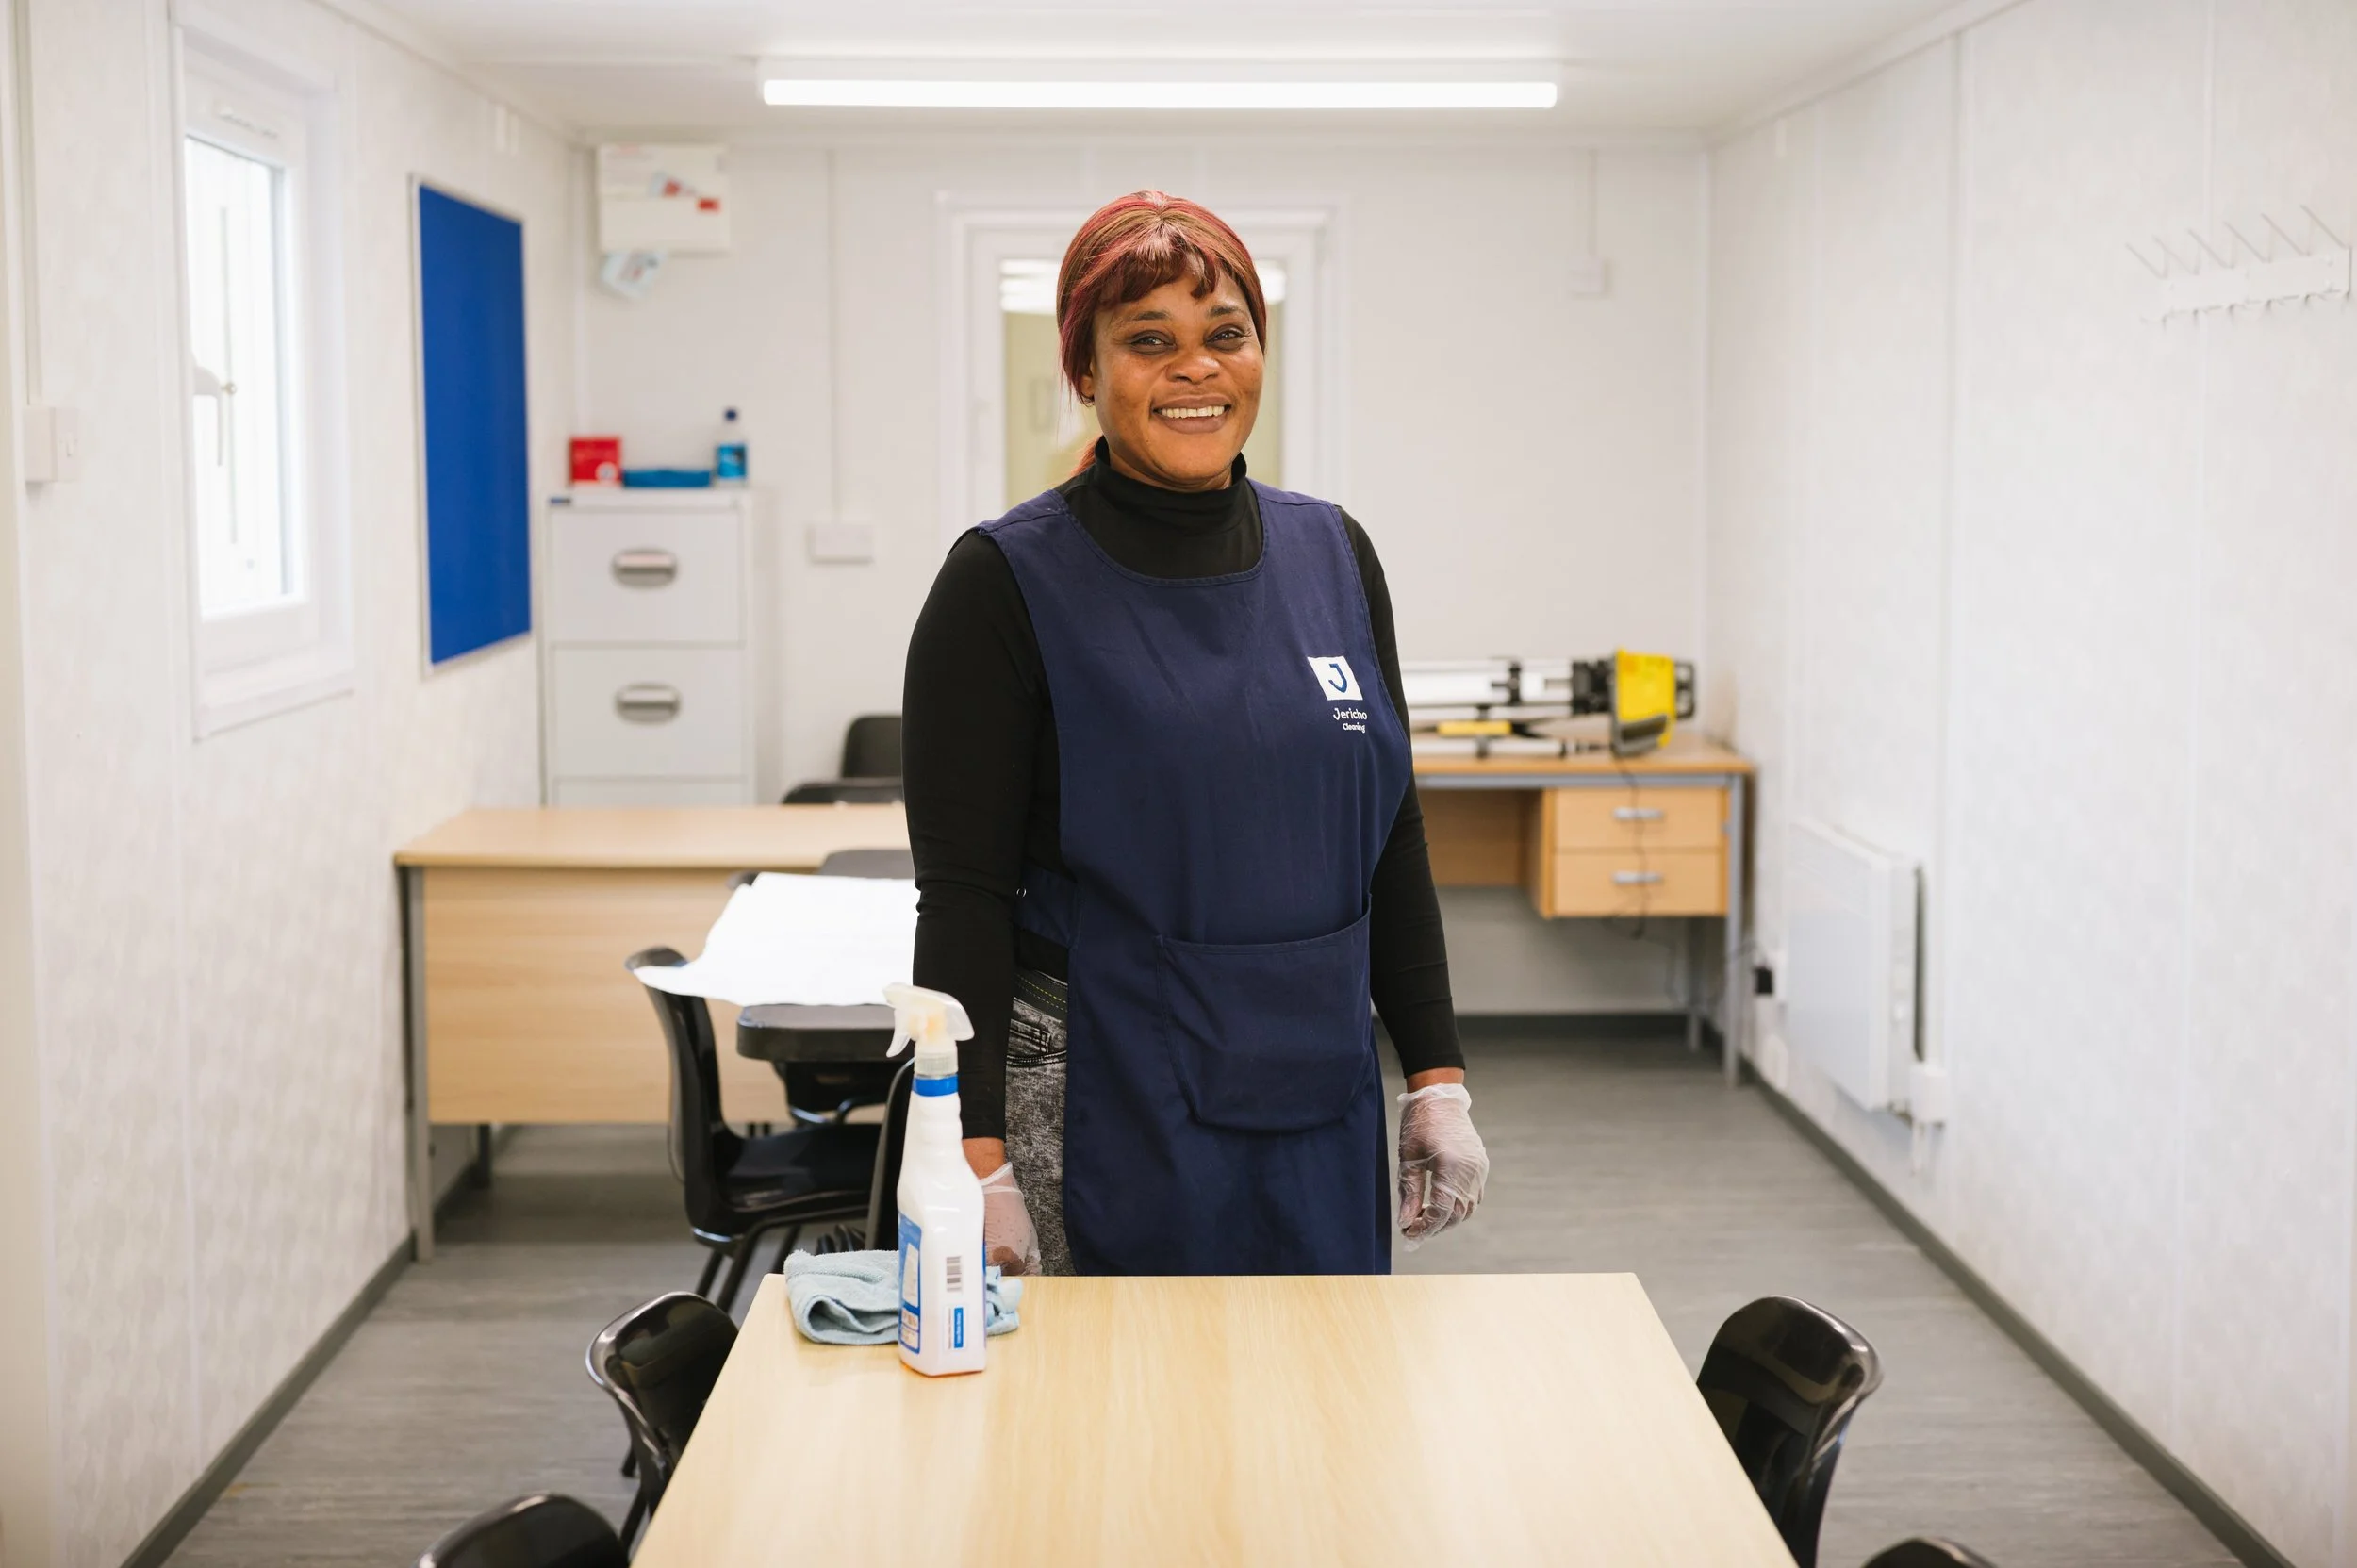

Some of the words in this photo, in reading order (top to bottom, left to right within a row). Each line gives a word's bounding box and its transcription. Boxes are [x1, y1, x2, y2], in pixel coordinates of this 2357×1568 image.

[1328, 664, 1347, 693] J
[1333, 707, 1367, 720] Jericho
[1343, 722, 1365, 733] Cleaning
